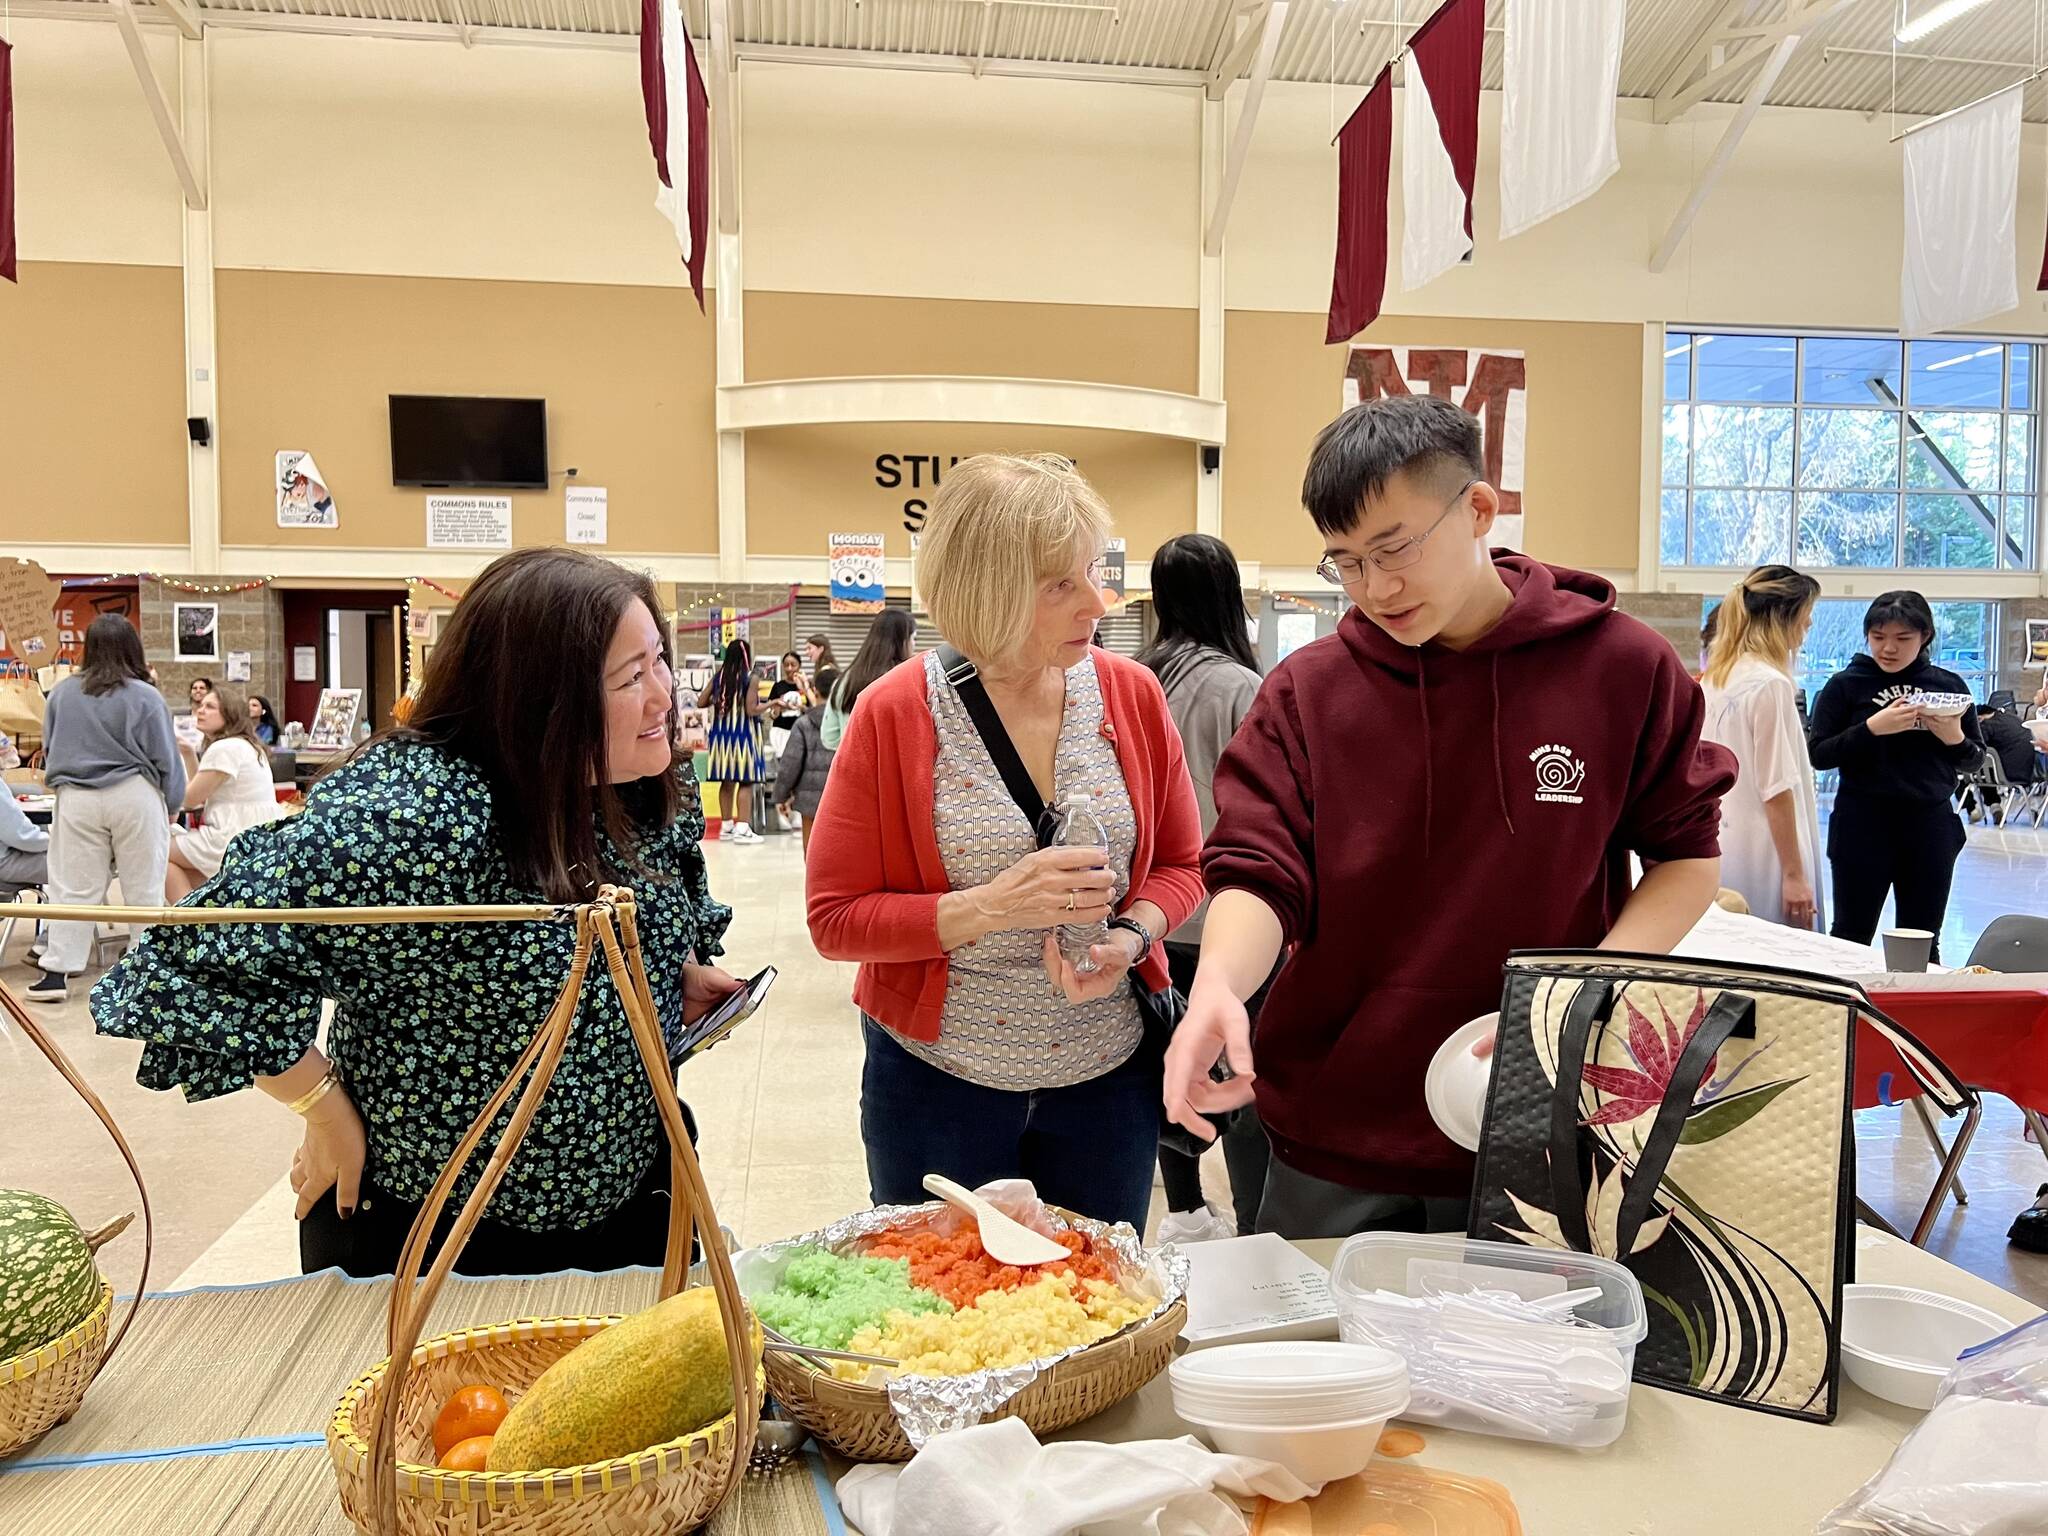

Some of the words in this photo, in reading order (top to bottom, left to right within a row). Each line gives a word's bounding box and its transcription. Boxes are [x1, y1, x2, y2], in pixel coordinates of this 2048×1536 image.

[430, 500, 476, 509] COMMONS
[478, 501, 508, 509] RULES
[832, 535, 881, 546] MONDAY
[1552, 744, 1572, 757] ASB
[1535, 793, 1584, 804] LEADERSHIP
